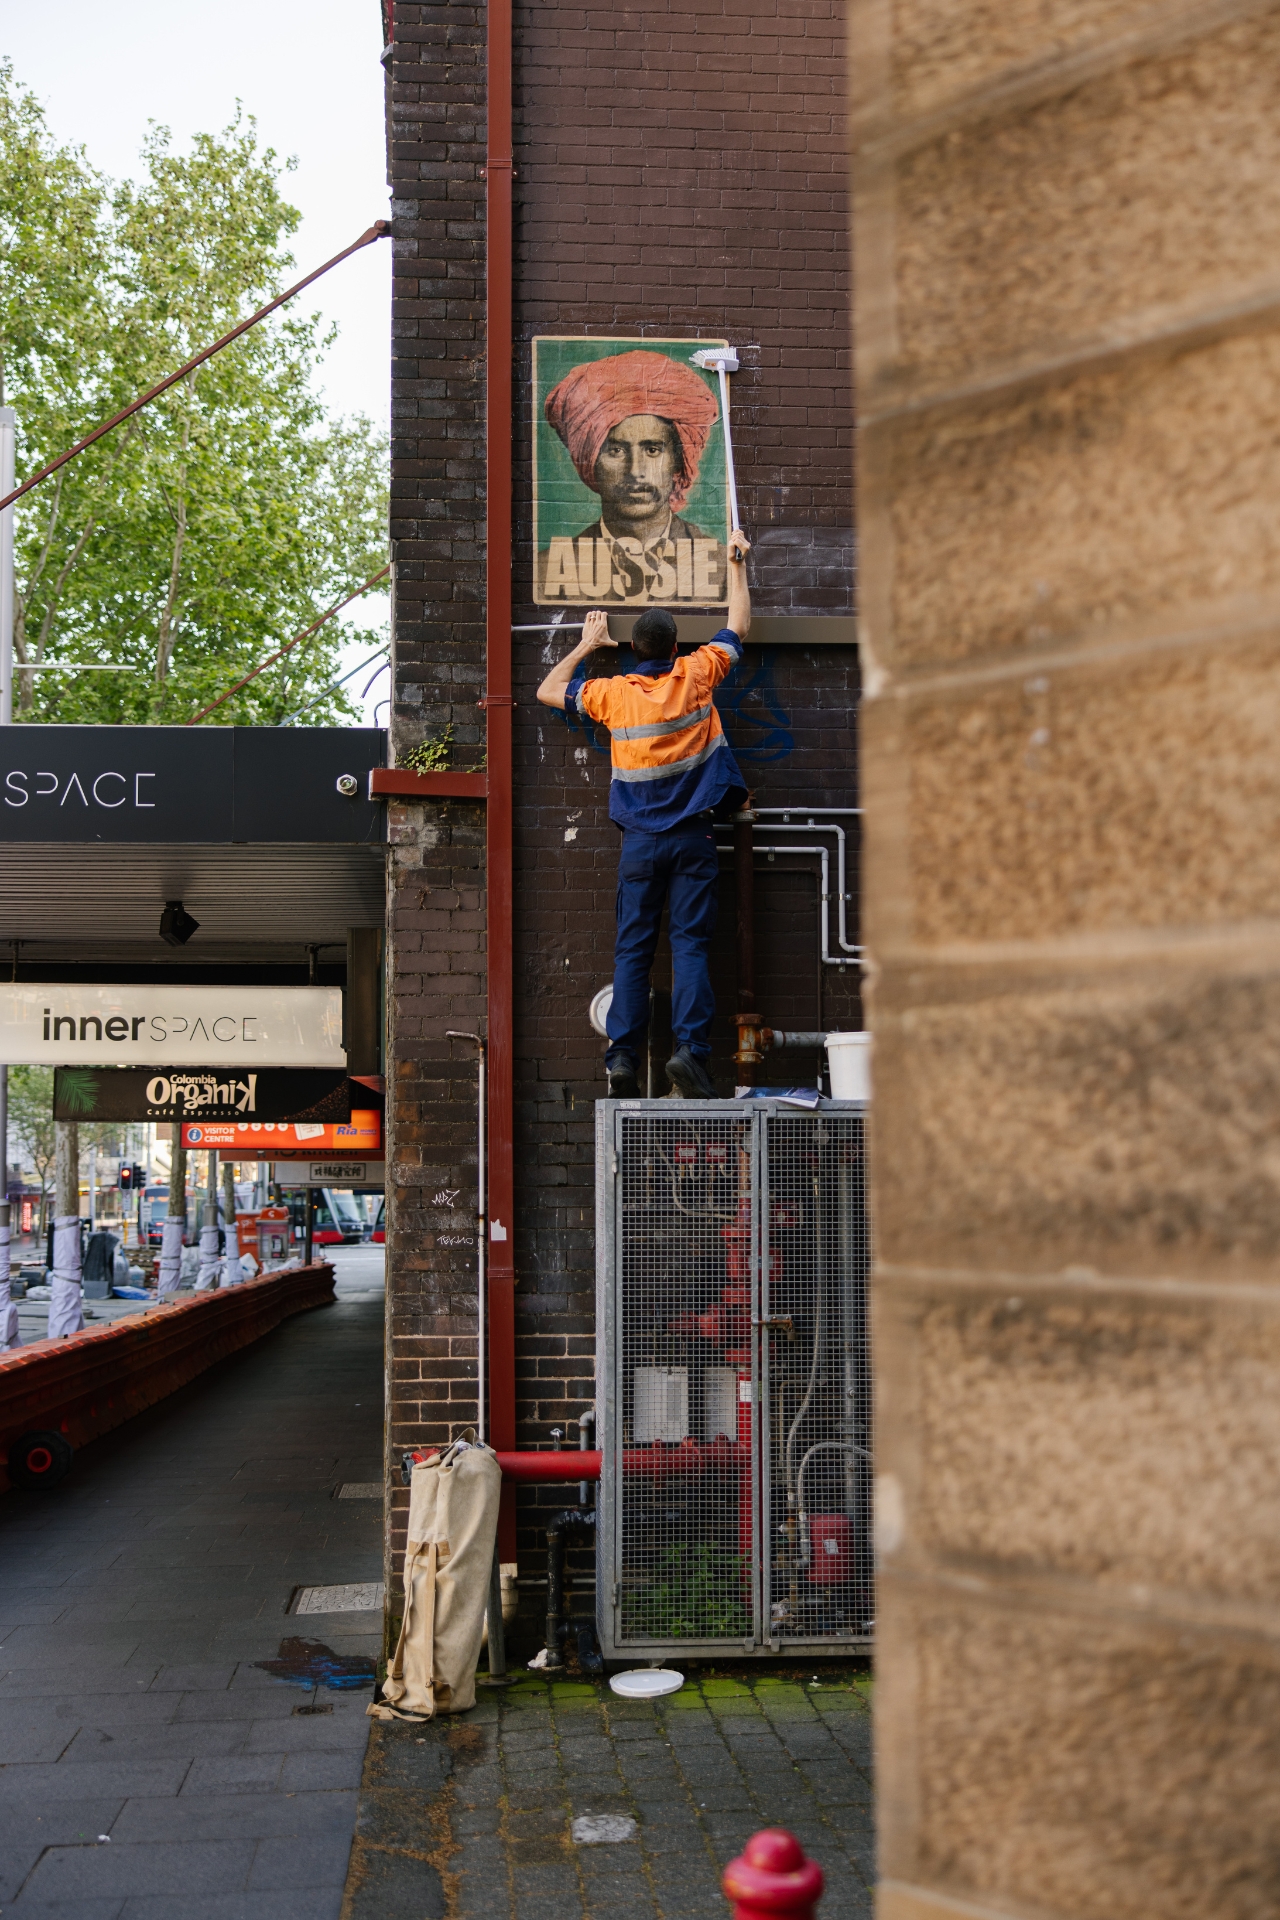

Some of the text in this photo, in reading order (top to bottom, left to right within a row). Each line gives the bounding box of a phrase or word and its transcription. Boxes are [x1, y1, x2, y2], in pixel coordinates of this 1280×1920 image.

[544, 536, 720, 598] AUSSIE
[4, 771, 156, 807] SPACE
[169, 1074, 216, 1085] Colombia
[182, 1109, 240, 1117] Espresso
[204, 1127, 235, 1135] VISITOR
[336, 1124, 357, 1135] Ria
[204, 1135, 235, 1143] CENTRE
